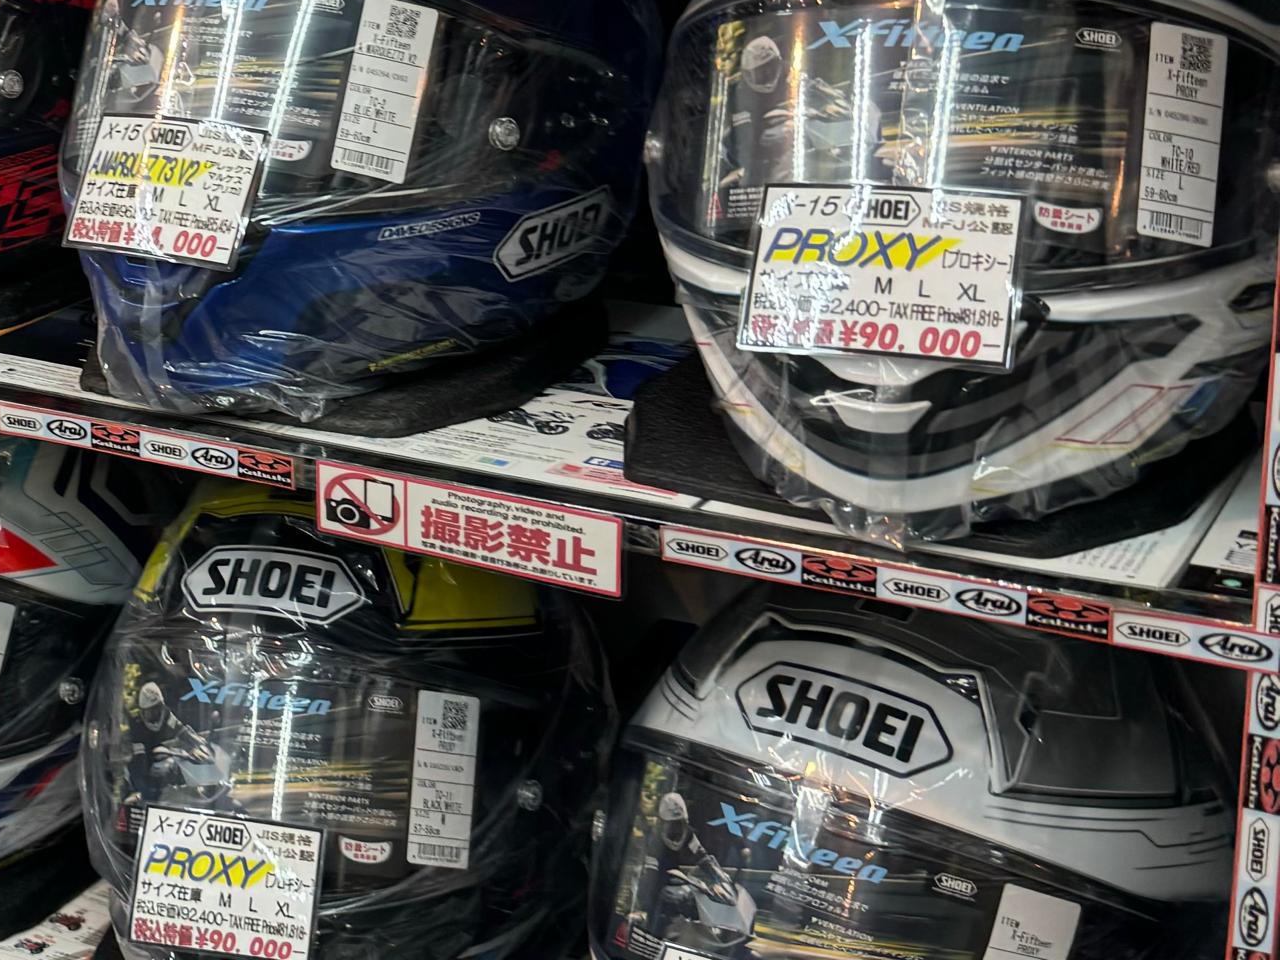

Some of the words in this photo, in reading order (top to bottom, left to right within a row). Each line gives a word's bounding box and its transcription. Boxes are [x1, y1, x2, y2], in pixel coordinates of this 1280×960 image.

[1082, 29, 1117, 44] SHOEI
[1155, 53, 1175, 65] ITEM
[1175, 83, 1199, 100] PROXY
[102, 123, 143, 141] X-15
[150, 128, 187, 148] SHOEI
[1178, 175, 1184, 191] L
[179, 190, 188, 207] L
[205, 194, 223, 213] XL
[763, 227, 943, 271] PROXY
[874, 277, 893, 296] M
[918, 279, 931, 298] L
[957, 281, 987, 303] XL
[888, 300, 910, 320] TAX
[911, 303, 937, 322] FREE
[6, 415, 39, 429] SHOEI
[51, 420, 85, 439] Arai
[150, 441, 184, 458] SHOEI
[195, 448, 231, 470] Arai
[431, 496, 460, 511] audio
[460, 503, 510, 522] recording
[511, 513, 529, 524] are
[531, 516, 587, 537] prohibited.
[515, 502, 544, 519] video
[546, 509, 566, 523] and
[420, 504, 598, 577] 撮影禁止
[674, 539, 722, 559] SHOEI
[739, 549, 792, 571] Arai
[201, 557, 337, 609] SHOEI
[803, 571, 876, 595] Kabuto
[892, 580, 942, 599] SHOEI
[960, 589, 1016, 613] Arai
[1028, 611, 1109, 636] Kabuto
[1126, 624, 1182, 644] SHOEI
[1204, 633, 1270, 659] Arai
[371, 695, 401, 709] SHOEI
[755, 673, 925, 764] SHOEI
[152, 815, 199, 837] X-15
[205, 824, 244, 846] SHOEI
[1251, 826, 1267, 875] SHOEI
[143, 843, 266, 890] PROXY
[937, 874, 975, 895] SHOEI
[140, 880, 203, 904] サイズ在庫
[218, 892, 232, 909] M
[249, 897, 259, 913] L
[274, 900, 296, 919] XL
[1242, 892, 1267, 941] Arai
[133, 917, 194, 946] 税込特価
